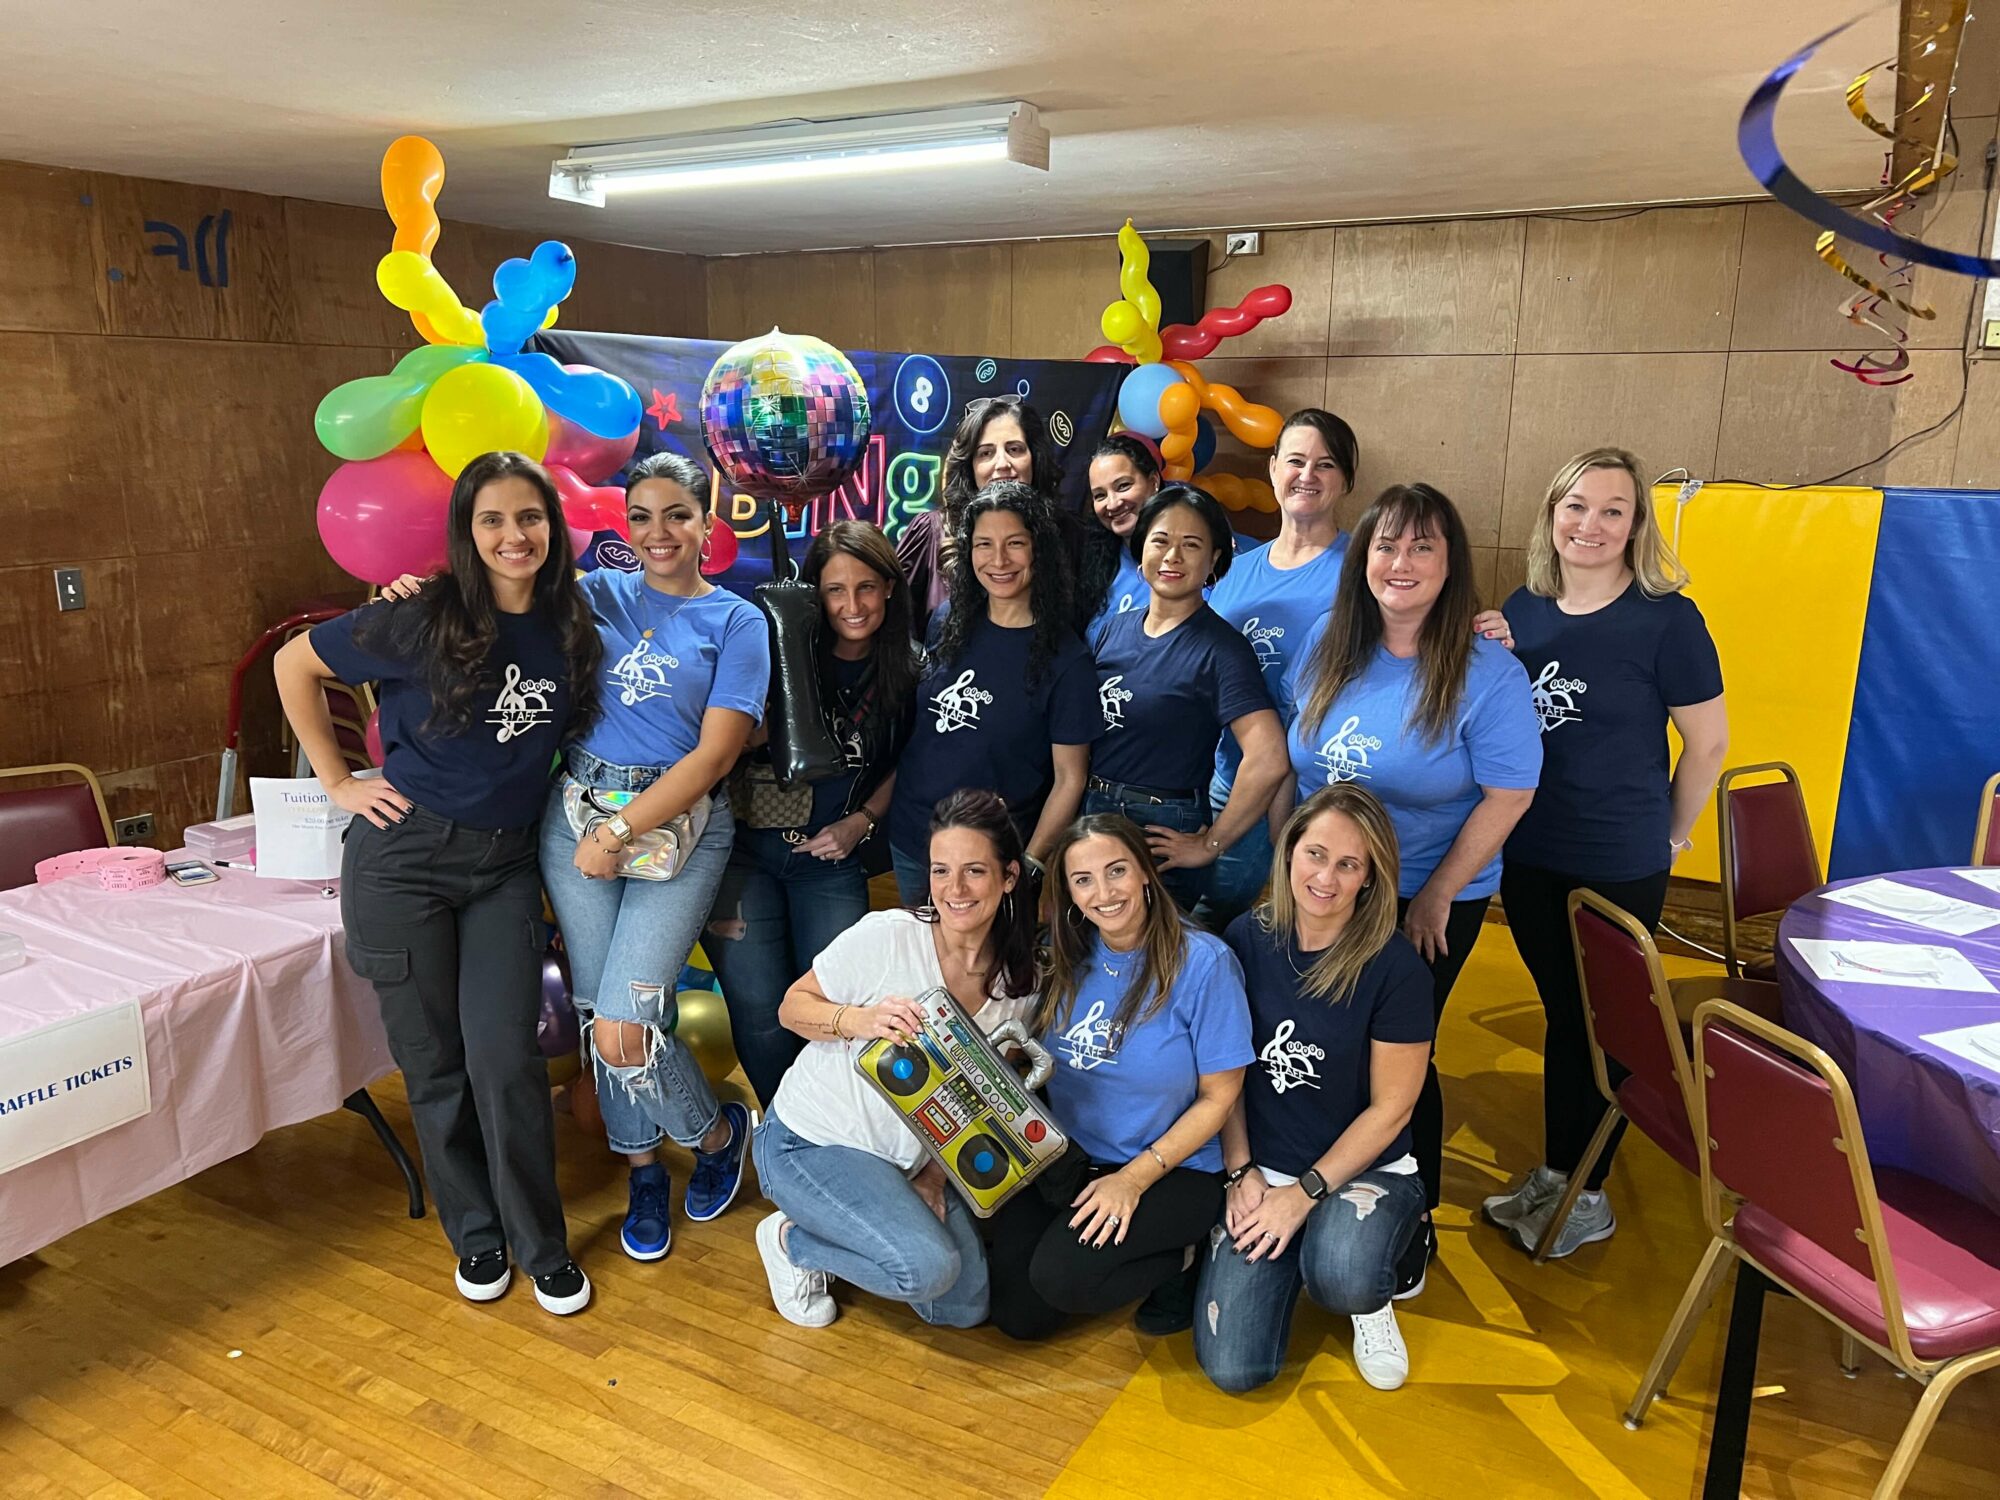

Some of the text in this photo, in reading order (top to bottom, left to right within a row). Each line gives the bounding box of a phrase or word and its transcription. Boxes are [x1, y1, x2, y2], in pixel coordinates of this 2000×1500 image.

[621, 675, 656, 692] STAFF
[502, 711, 538, 721] STAFF
[939, 704, 968, 722] STAFF
[1327, 756, 1357, 773] STAFF
[281, 792, 328, 803] Tuition
[1071, 1043, 1102, 1058] STAFF
[63, 1056, 133, 1091] TICKETS
